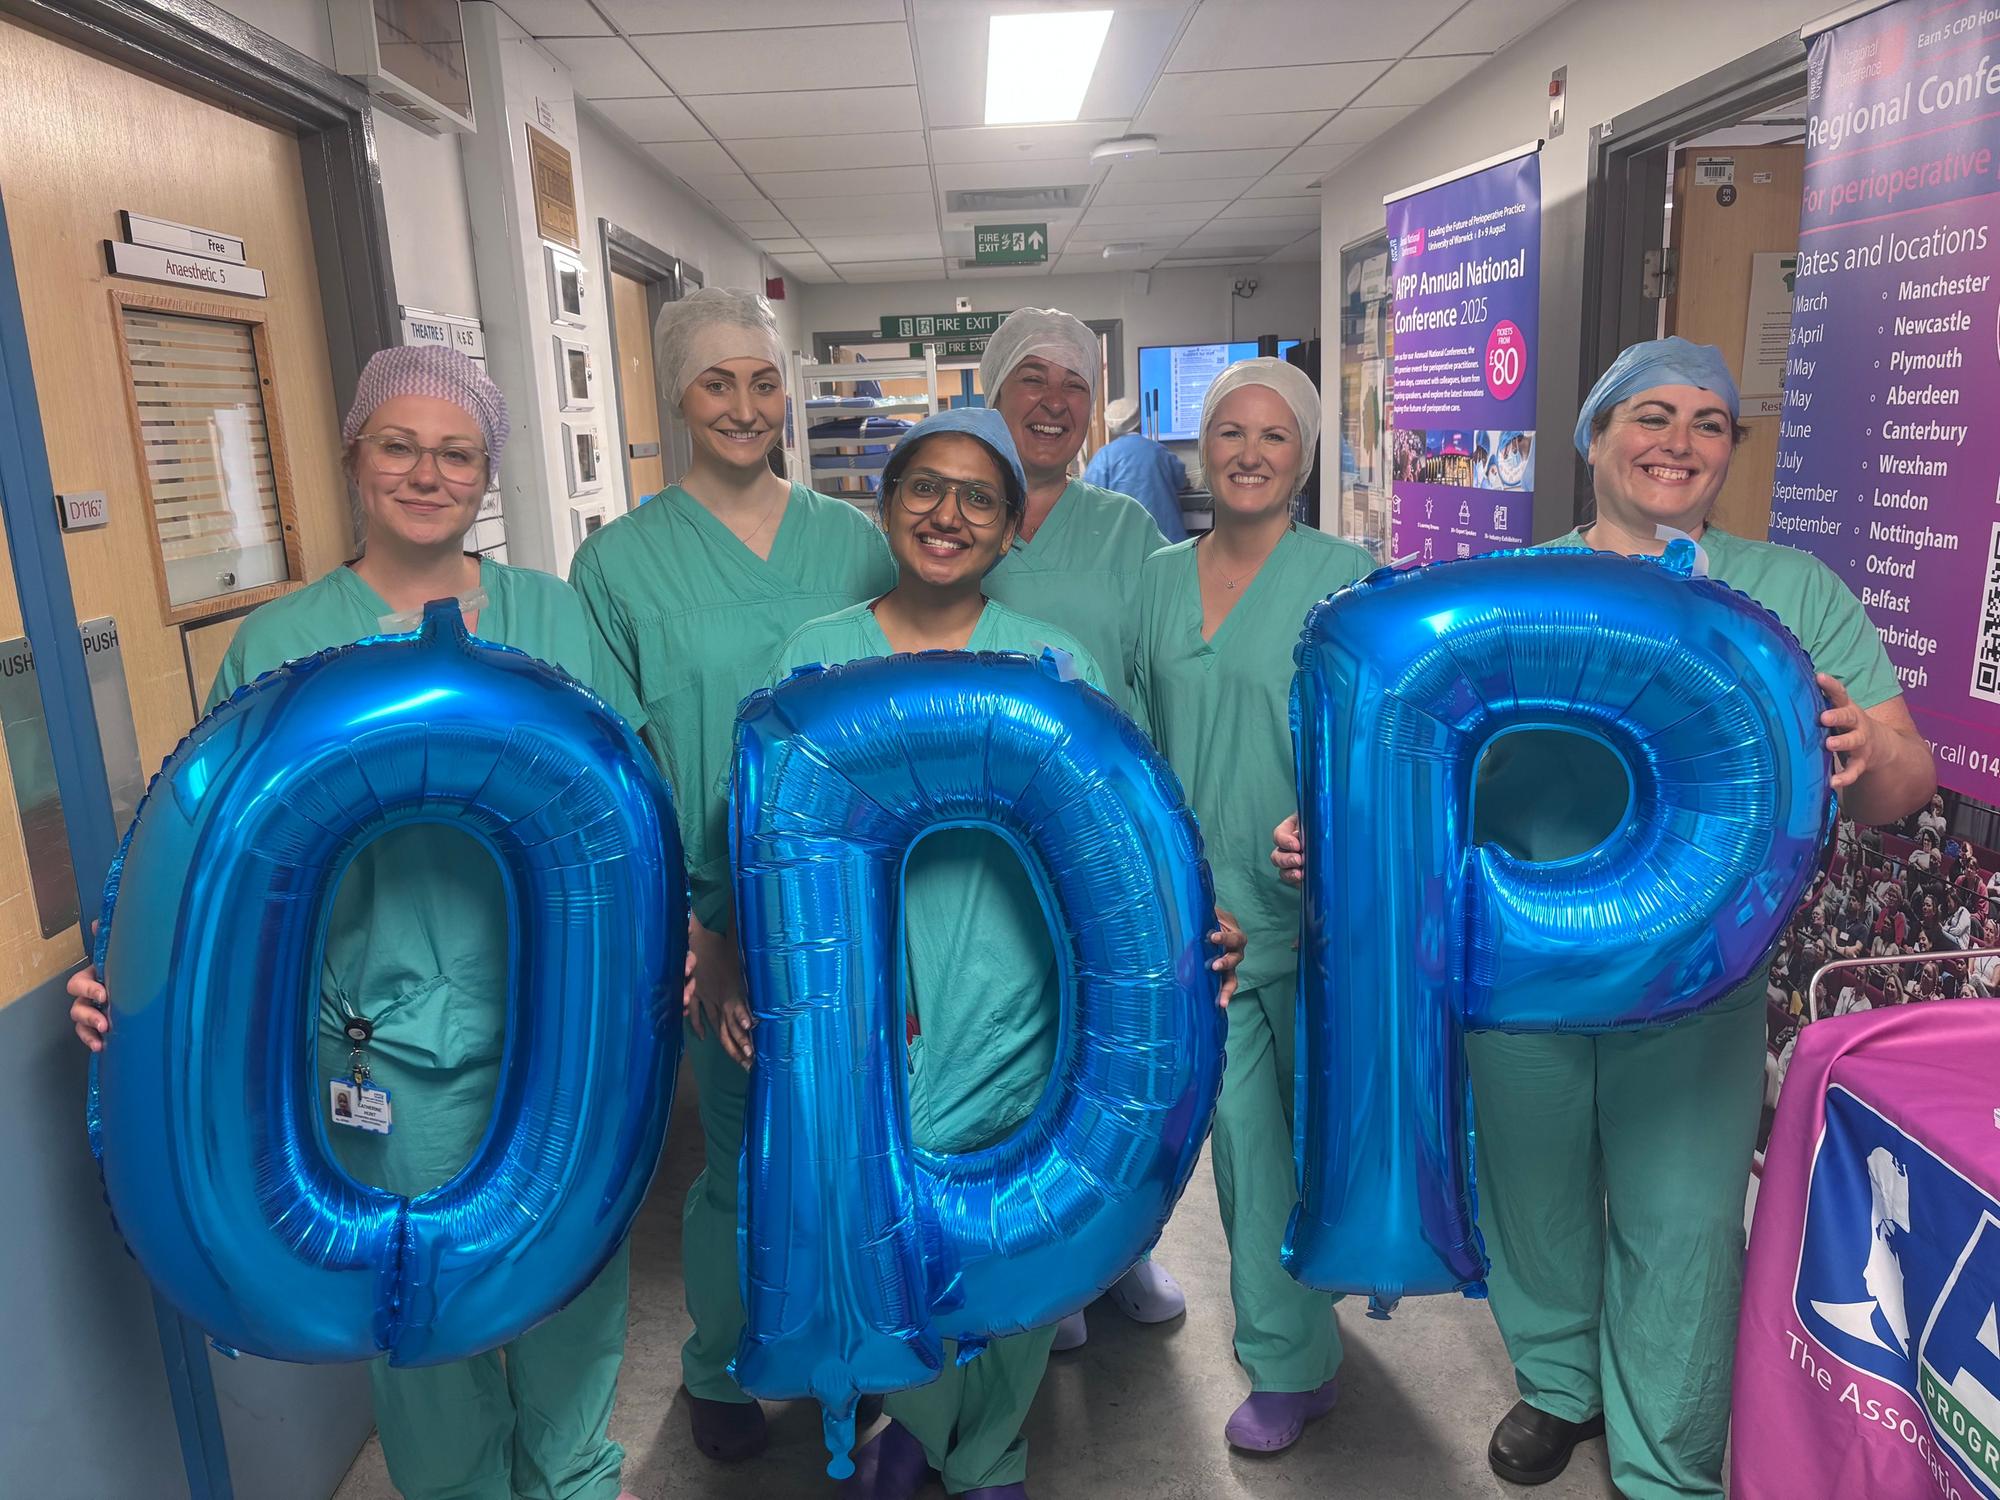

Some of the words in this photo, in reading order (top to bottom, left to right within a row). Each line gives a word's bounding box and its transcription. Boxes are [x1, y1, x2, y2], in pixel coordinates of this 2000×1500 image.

[1917, 30, 1941, 49] Earn
[1943, 25, 1951, 39] 5
[1952, 15, 1976, 36] CPD
[1807, 82, 1911, 150] Regional
[1918, 55, 2000, 115] Confe
[1802, 186, 1825, 213] For
[1828, 148, 1992, 216] perioperative
[1428, 226, 1445, 238] Leading
[1453, 219, 1468, 230] Future
[1473, 209, 1504, 225] Perioperative
[1504, 203, 1526, 216] Practice
[208, 239, 225, 253] Free
[978, 233, 1000, 242] FIRE
[978, 243, 1000, 253] EXIT
[1428, 239, 1449, 251] University
[1489, 223, 1506, 236] August
[1796, 250, 1840, 278] Dates
[1844, 234, 1884, 270] and
[1887, 225, 1988, 264] locations
[166, 259, 217, 283] Anaesthetic
[220, 269, 226, 284] 5
[1396, 274, 1418, 301] AfPP
[1419, 262, 1464, 296] Annual
[1467, 248, 1525, 287] National
[1898, 274, 1990, 301] Manchester
[1796, 291, 1828, 313] March
[936, 318, 960, 332] FIRE
[966, 316, 992, 330] EXIT
[1394, 306, 1457, 334] Conference
[1460, 297, 1488, 325] 2025
[1894, 310, 1971, 336] Newcastle
[411, 323, 439, 341] THEATRE
[439, 327, 444, 342] 5
[1496, 327, 1513, 336] TICKETS
[1498, 336, 1511, 345] FROM
[1797, 323, 1824, 347] April
[948, 343, 966, 352] FIRE
[1489, 347, 1519, 385] £80
[1792, 358, 1816, 380] May
[1890, 347, 1963, 375] Plymouth
[1789, 389, 1812, 411] May
[1886, 384, 1960, 405] Aberdeen
[1785, 420, 1812, 438] June
[1882, 420, 1968, 447] Canterbury
[1782, 450, 1803, 473] July
[1879, 455, 1948, 476] Wrexham
[1775, 481, 1838, 503] September
[1874, 488, 1929, 511] London
[1776, 511, 1842, 535] September
[1870, 521, 1958, 550] Nottingham
[1866, 555, 1916, 579] Oxford
[1862, 587, 1911, 613] Belfast
[83, 630, 119, 655] PUSH
[1876, 625, 1937, 656] mbridge
[1894, 665, 1928, 688] urgh
[1940, 744, 1966, 766] call
[1969, 750, 2000, 777] 014
[1786, 1330, 1832, 1391] The
[1926, 1378, 2000, 1473] PROGR
